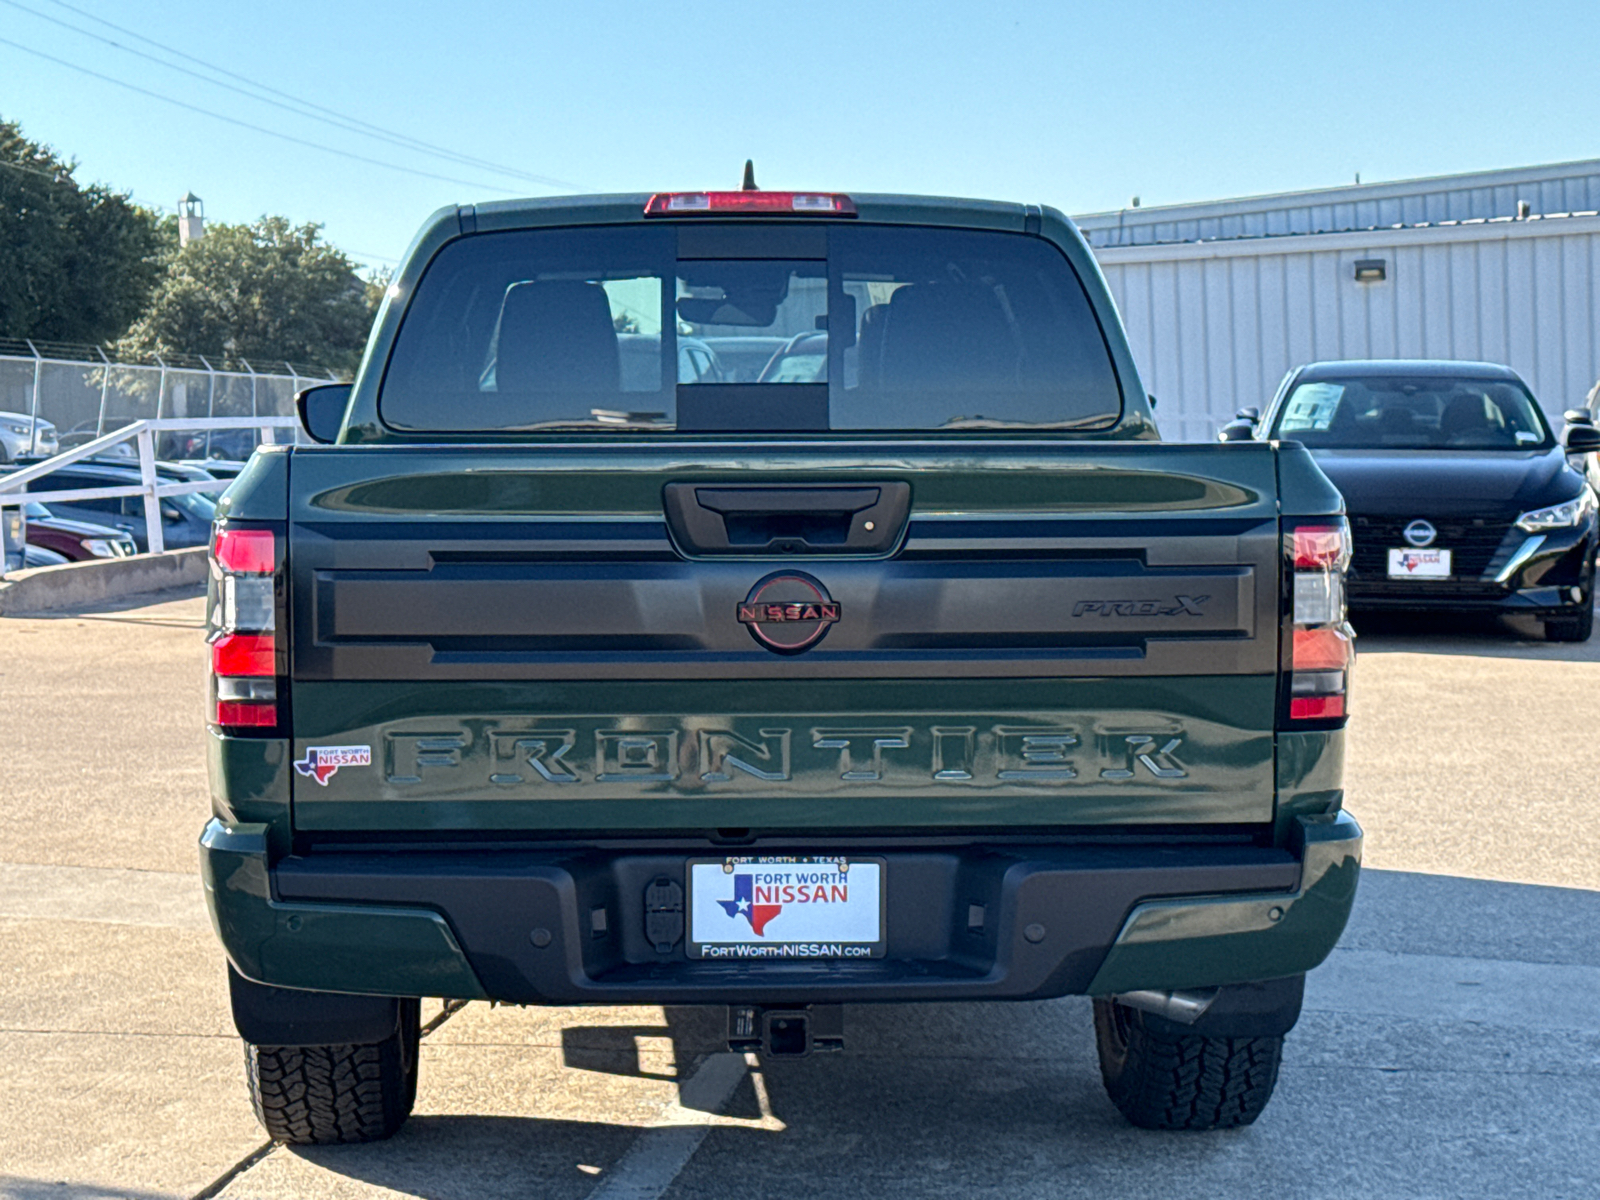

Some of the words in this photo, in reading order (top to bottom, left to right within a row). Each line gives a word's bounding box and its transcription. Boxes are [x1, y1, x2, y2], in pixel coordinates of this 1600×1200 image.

[1071, 594, 1211, 617] PRO-X
[740, 606, 836, 620] NISSAN
[318, 754, 370, 764] NISSAN
[383, 725, 1188, 784] FRONTIER
[725, 856, 754, 864] FORT
[758, 856, 797, 864] WORTH
[812, 856, 847, 864] TEXAS
[754, 874, 792, 884] FORT
[796, 873, 848, 884] WORTH
[754, 884, 848, 903] NISSAN
